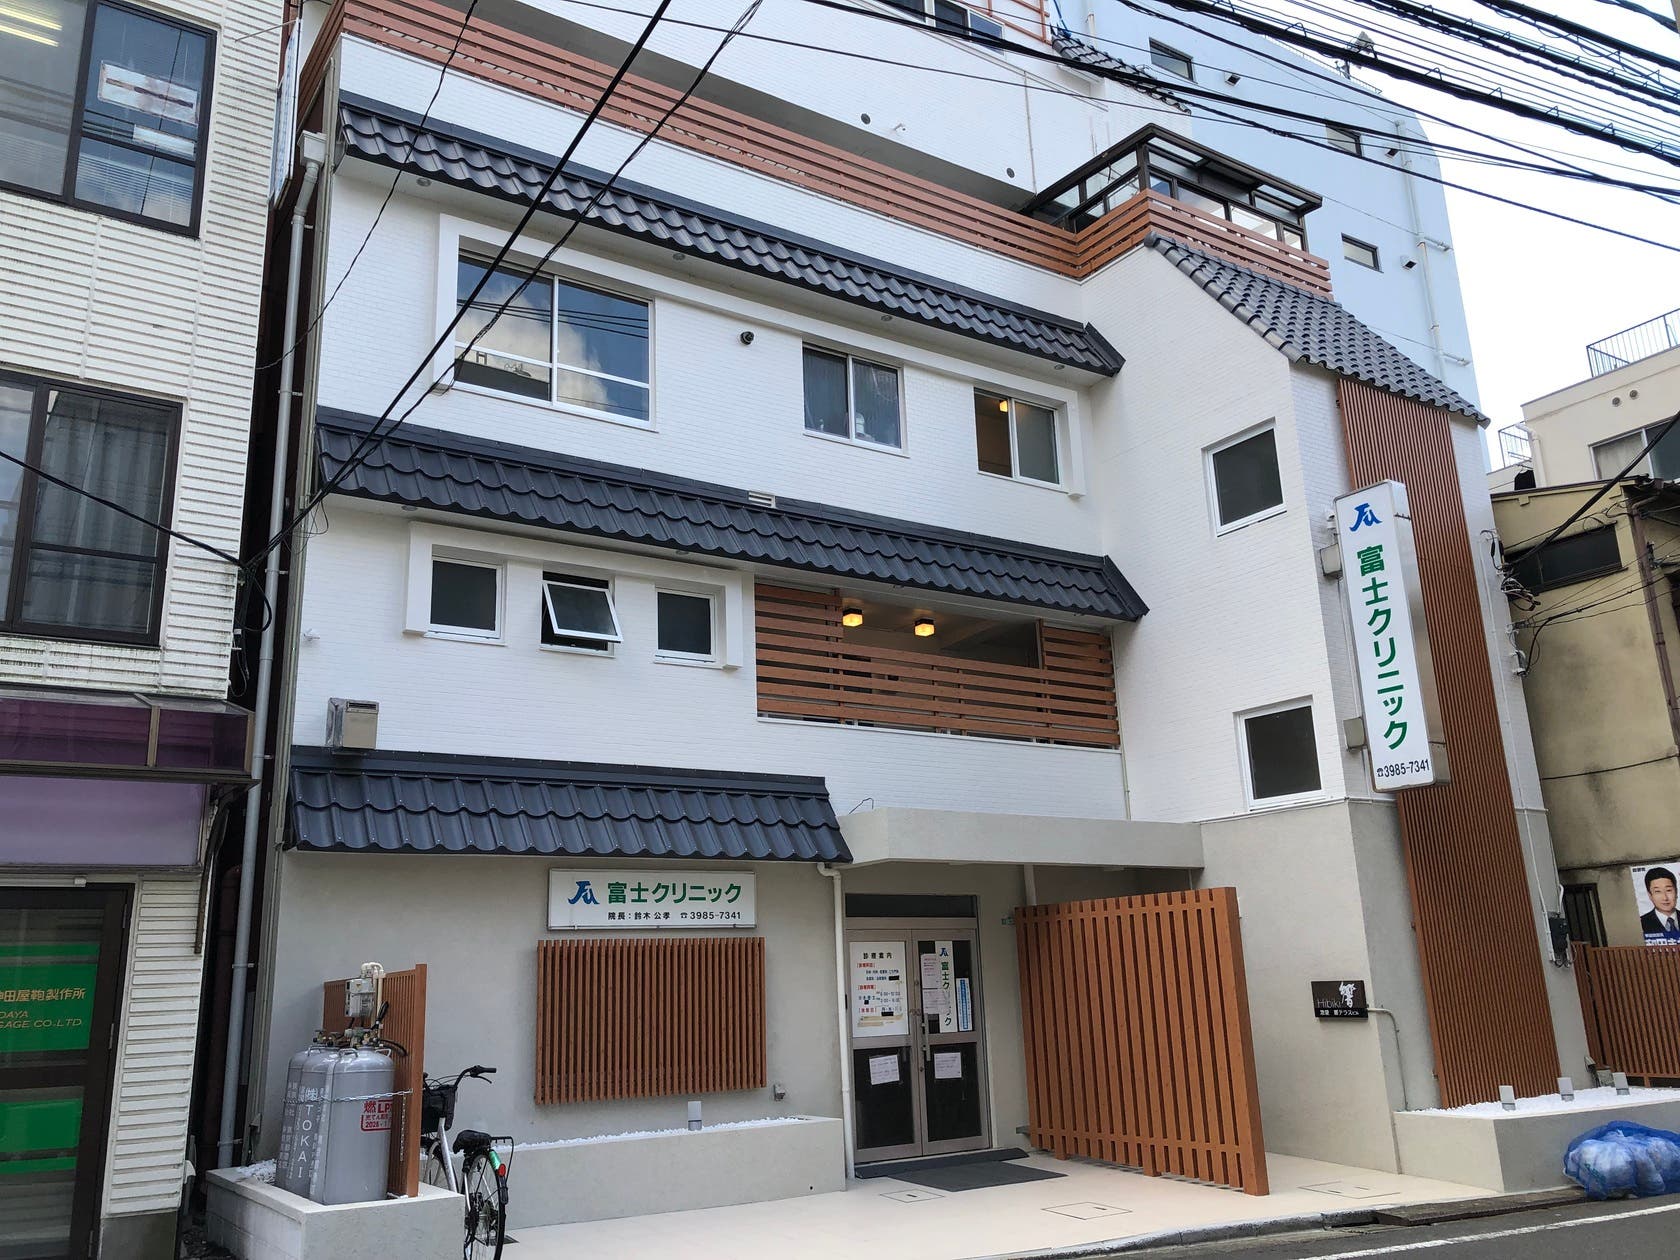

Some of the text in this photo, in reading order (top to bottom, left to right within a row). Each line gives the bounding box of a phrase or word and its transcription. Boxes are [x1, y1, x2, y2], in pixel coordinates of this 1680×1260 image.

[1357, 545, 1408, 750] 富士クリニック
[1384, 758, 1430, 779] 3985-7341
[607, 881, 742, 904] 富士クリニック
[690, 911, 741, 920] 3985-7341
